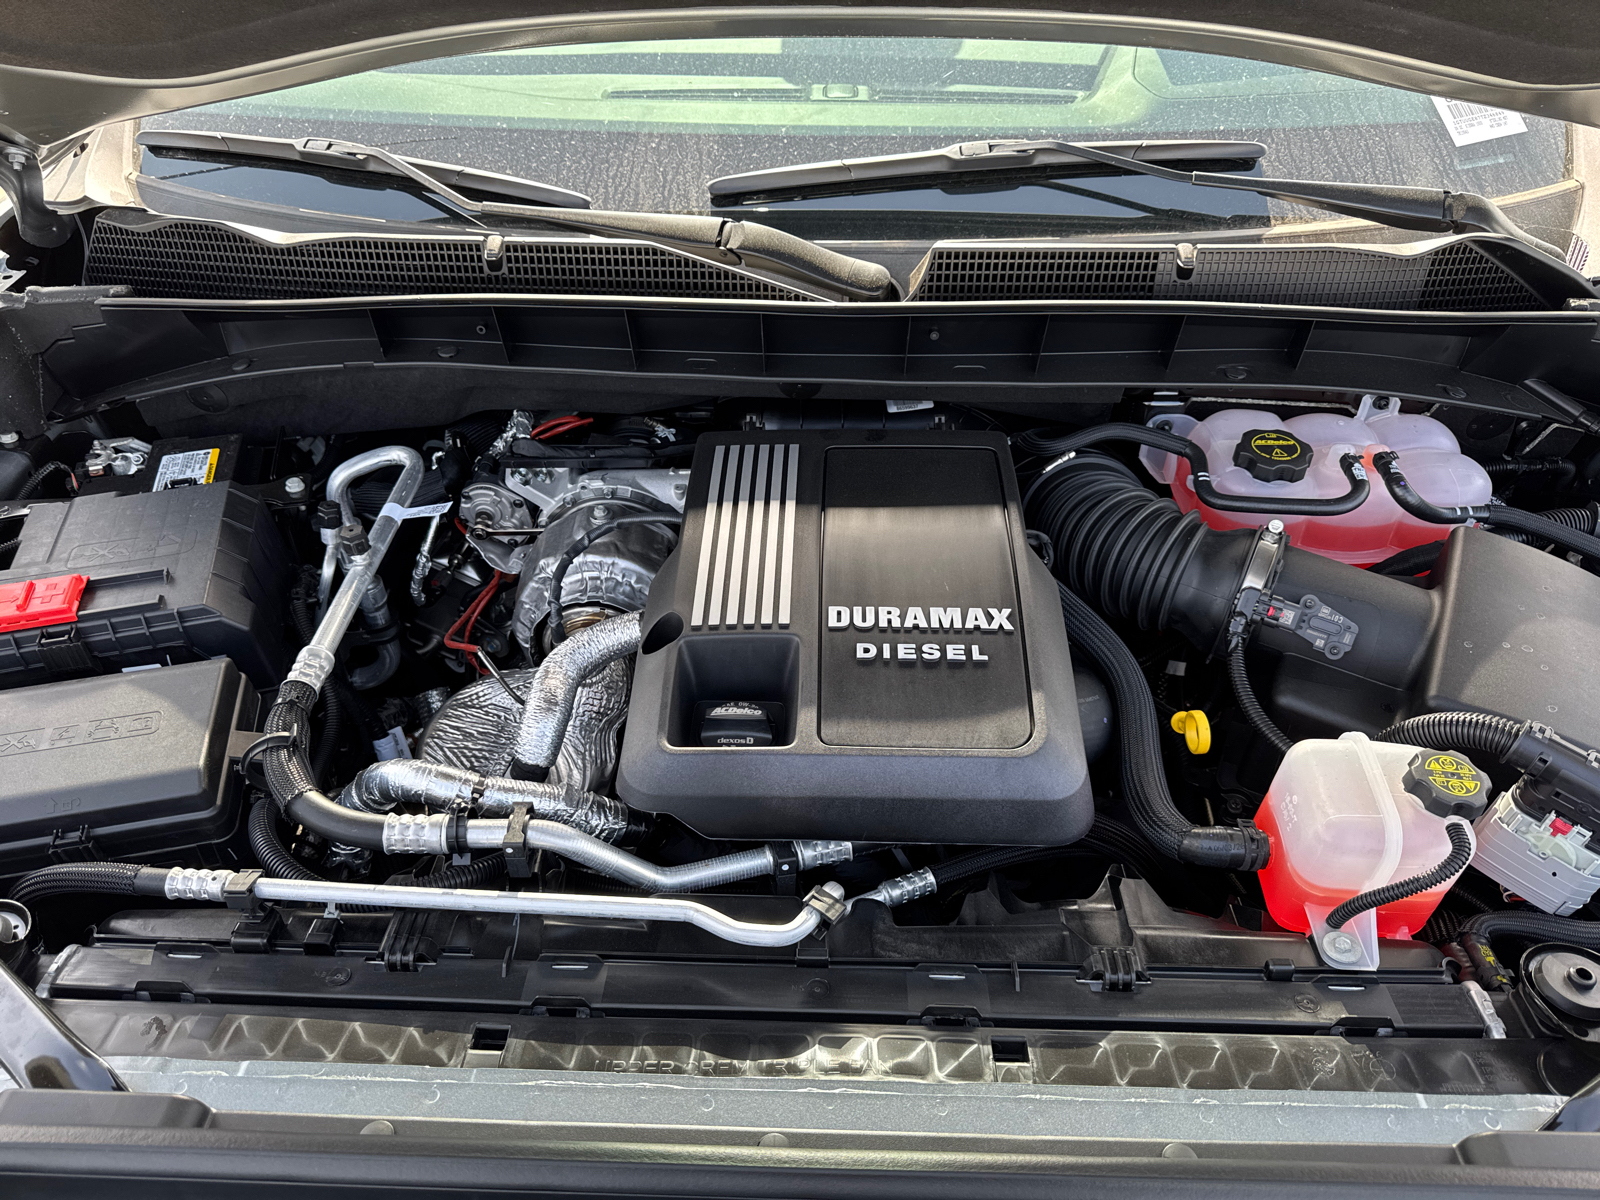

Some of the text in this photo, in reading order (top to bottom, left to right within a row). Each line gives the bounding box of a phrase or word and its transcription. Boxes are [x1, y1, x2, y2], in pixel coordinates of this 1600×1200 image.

[828, 606, 1014, 632] DURAMAX
[856, 643, 988, 661] DIESEL
[711, 706, 763, 716] ACDelco
[758, 1060, 841, 1075] TRIPLE
